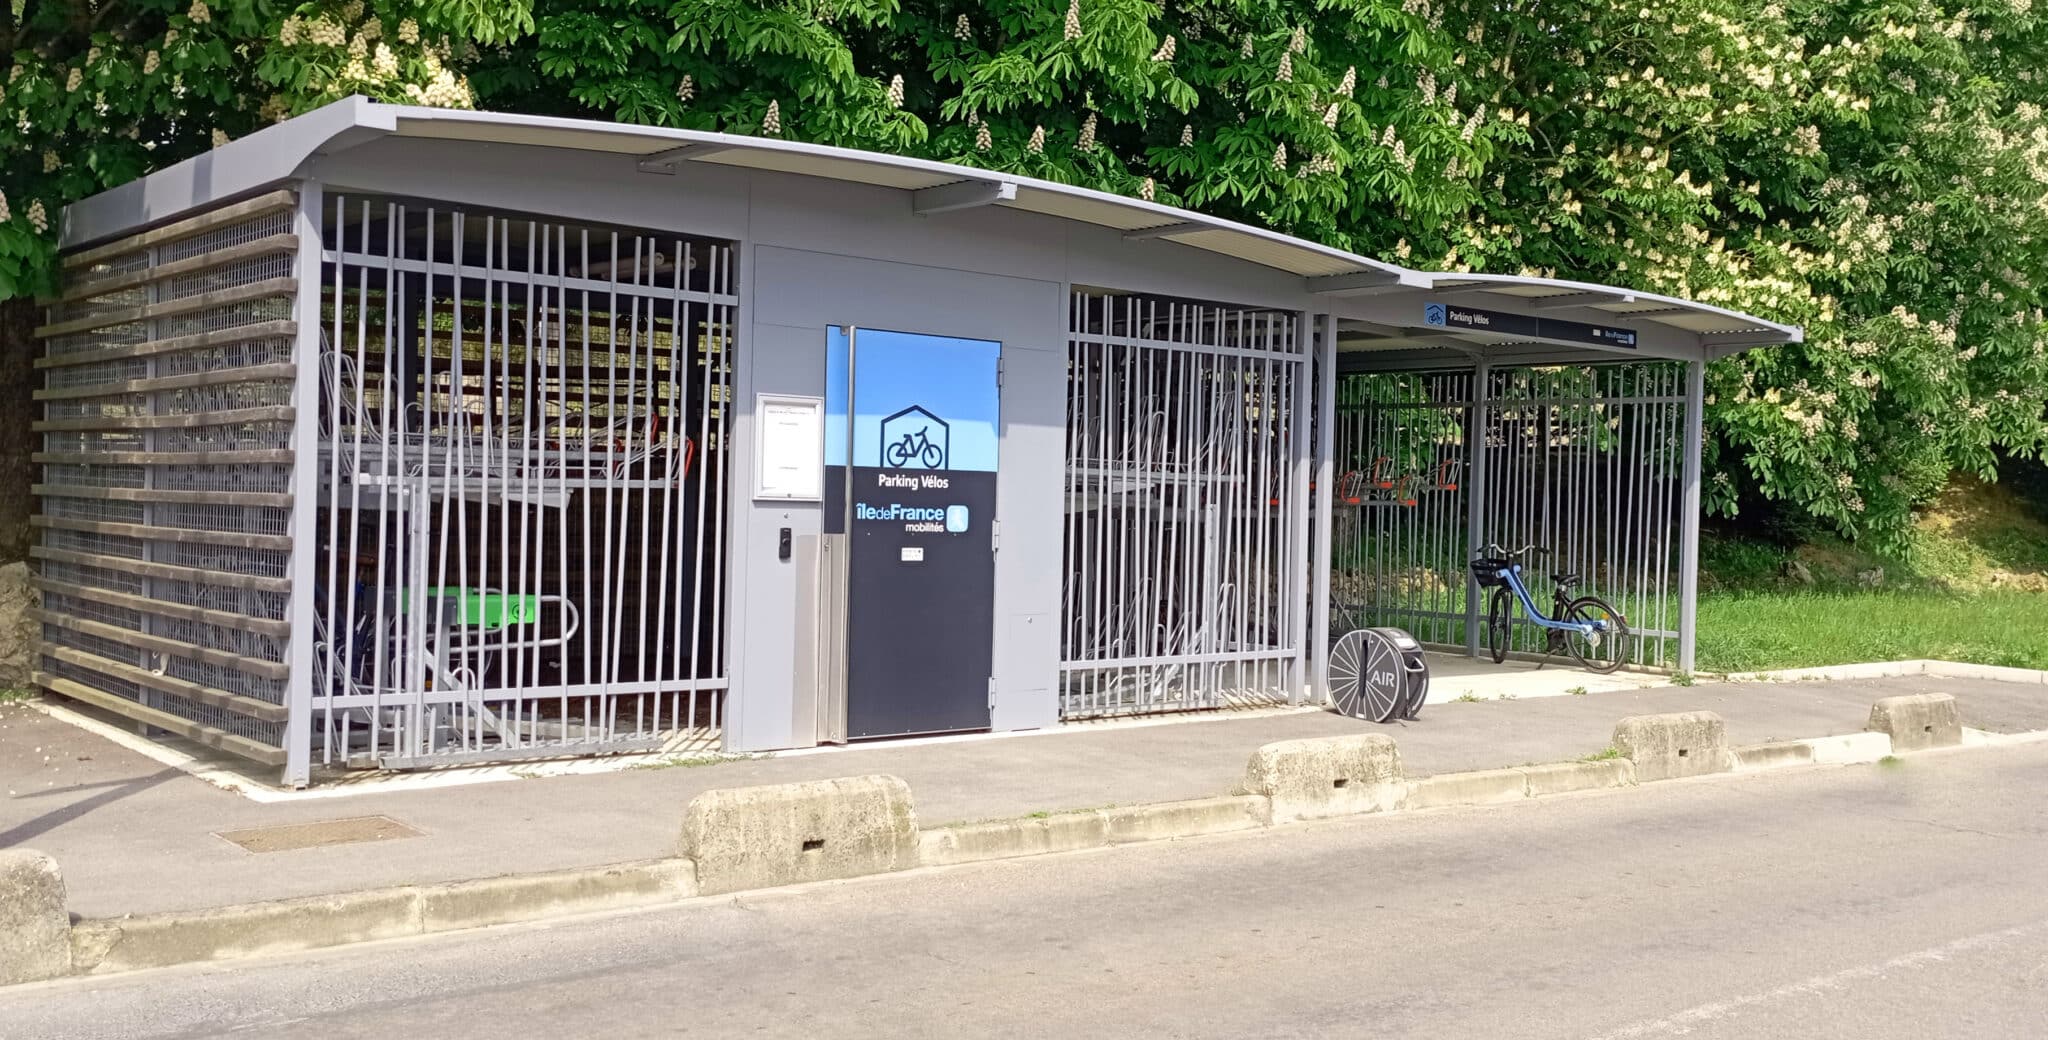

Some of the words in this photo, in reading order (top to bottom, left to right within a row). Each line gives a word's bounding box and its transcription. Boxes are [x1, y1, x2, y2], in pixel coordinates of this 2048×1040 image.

[1449, 310, 1473, 325] Parking
[879, 474, 919, 490] Parking
[921, 475, 949, 489] Vélos
[905, 522, 944, 533] mobilités
[1371, 670, 1395, 687] AIR
